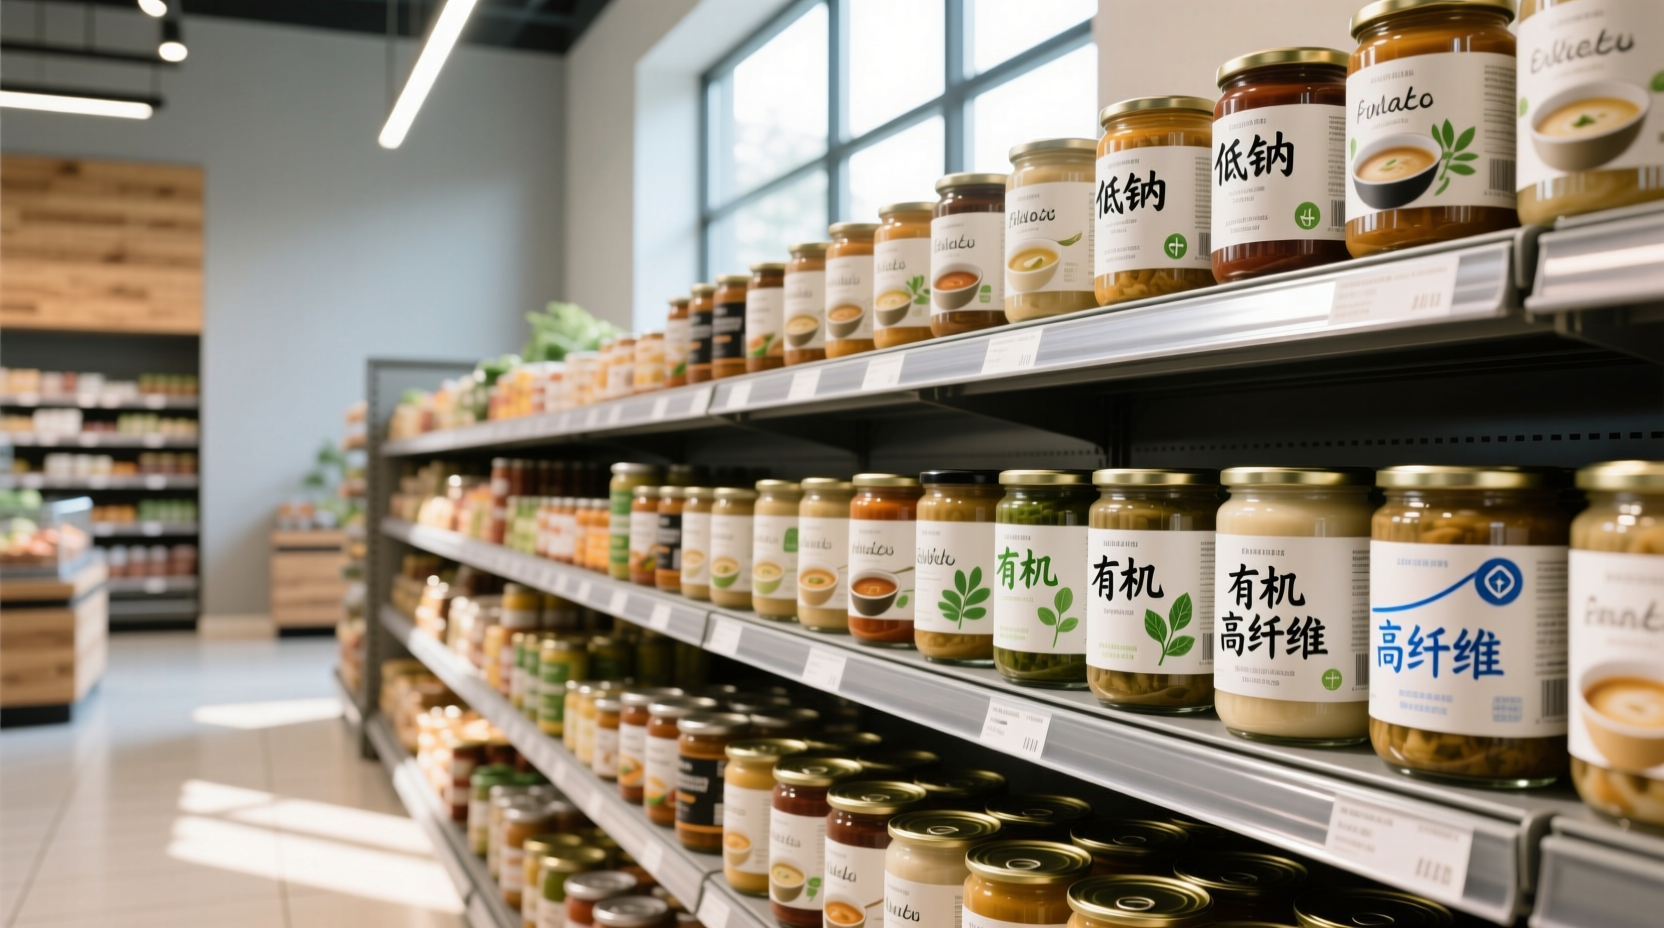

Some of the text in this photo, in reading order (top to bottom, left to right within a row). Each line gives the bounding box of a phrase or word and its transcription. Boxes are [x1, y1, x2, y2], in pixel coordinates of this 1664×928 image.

[1214, 131, 1294, 186] 低钠
[1096, 170, 1165, 219] 低钠
[997, 546, 1058, 590] 有机
[1092, 554, 1164, 602] 有机
[1228, 563, 1306, 610] 有机
[1220, 611, 1329, 660] 高纤维
[1377, 619, 1504, 681] 高纤维
